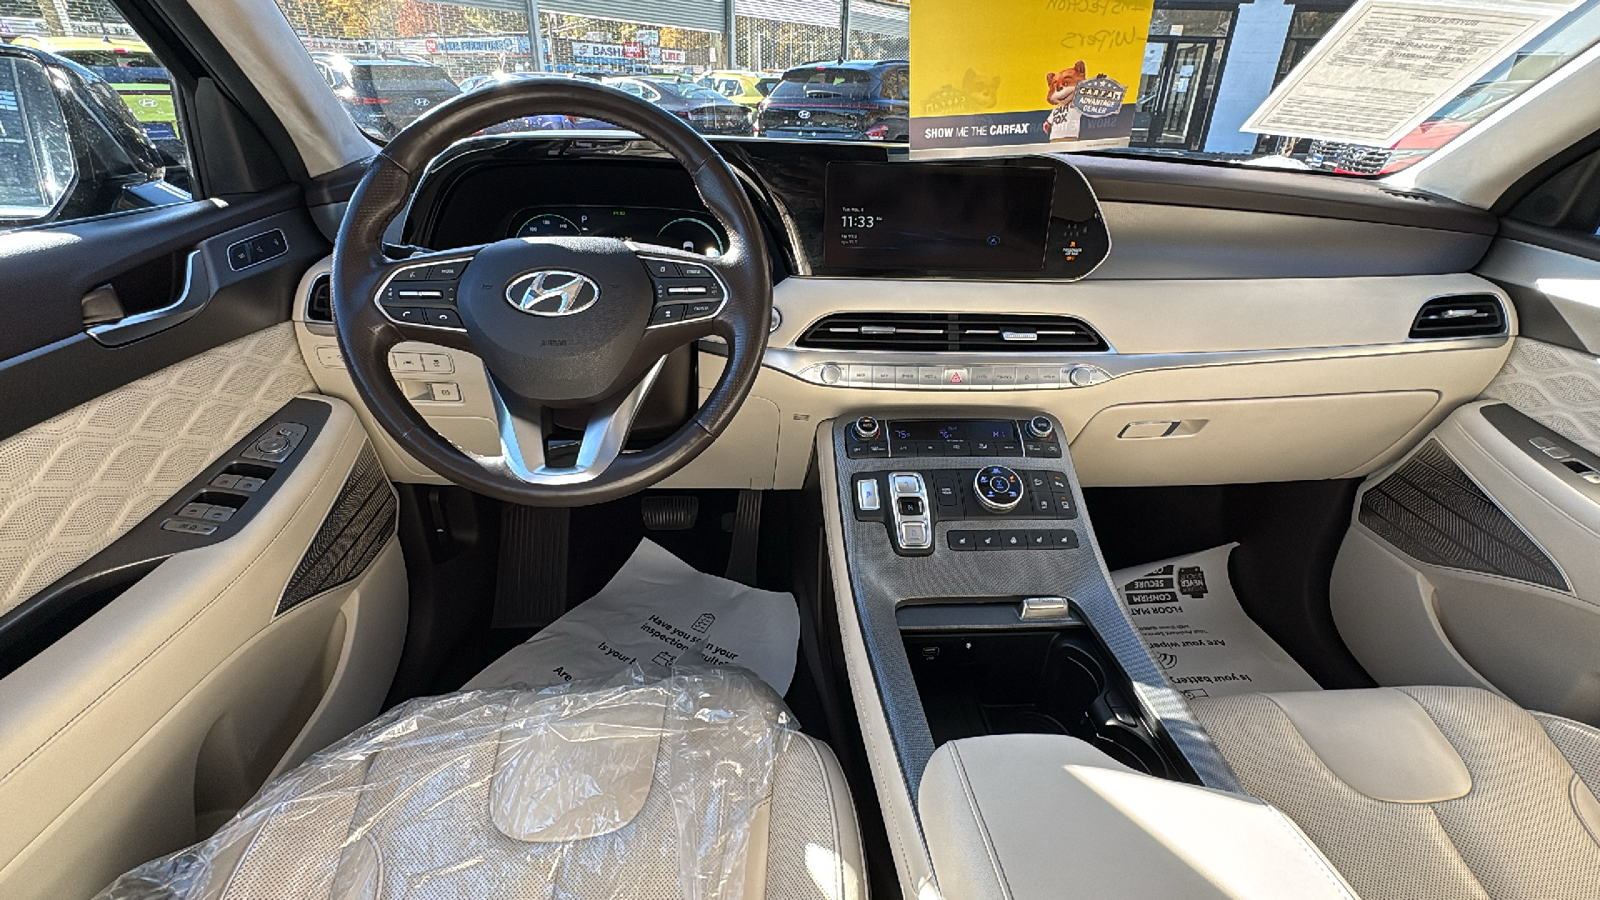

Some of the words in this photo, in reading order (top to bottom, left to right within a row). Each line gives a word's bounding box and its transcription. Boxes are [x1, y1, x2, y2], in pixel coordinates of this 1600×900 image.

[593, 46, 624, 57] BASH
[1079, 86, 1122, 101] CARFAX
[1079, 97, 1116, 108] ADVANTAGE
[925, 128, 953, 139] SHOW
[956, 127, 969, 137] ME
[971, 126, 987, 136] THE
[990, 123, 1030, 136] CARFAX
[841, 216, 874, 228] 11:33
[1134, 579, 1164, 589] SECURE
[1132, 593, 1172, 602] CONFIRM
[1152, 606, 1184, 614] FLOOR
[640, 622, 689, 651] inspection
[648, 614, 673, 631] Have
[670, 627, 691, 640] you
[712, 646, 739, 660] your
[598, 642, 608, 651] Is
[605, 647, 630, 663] your
[553, 666, 573, 682] Are
